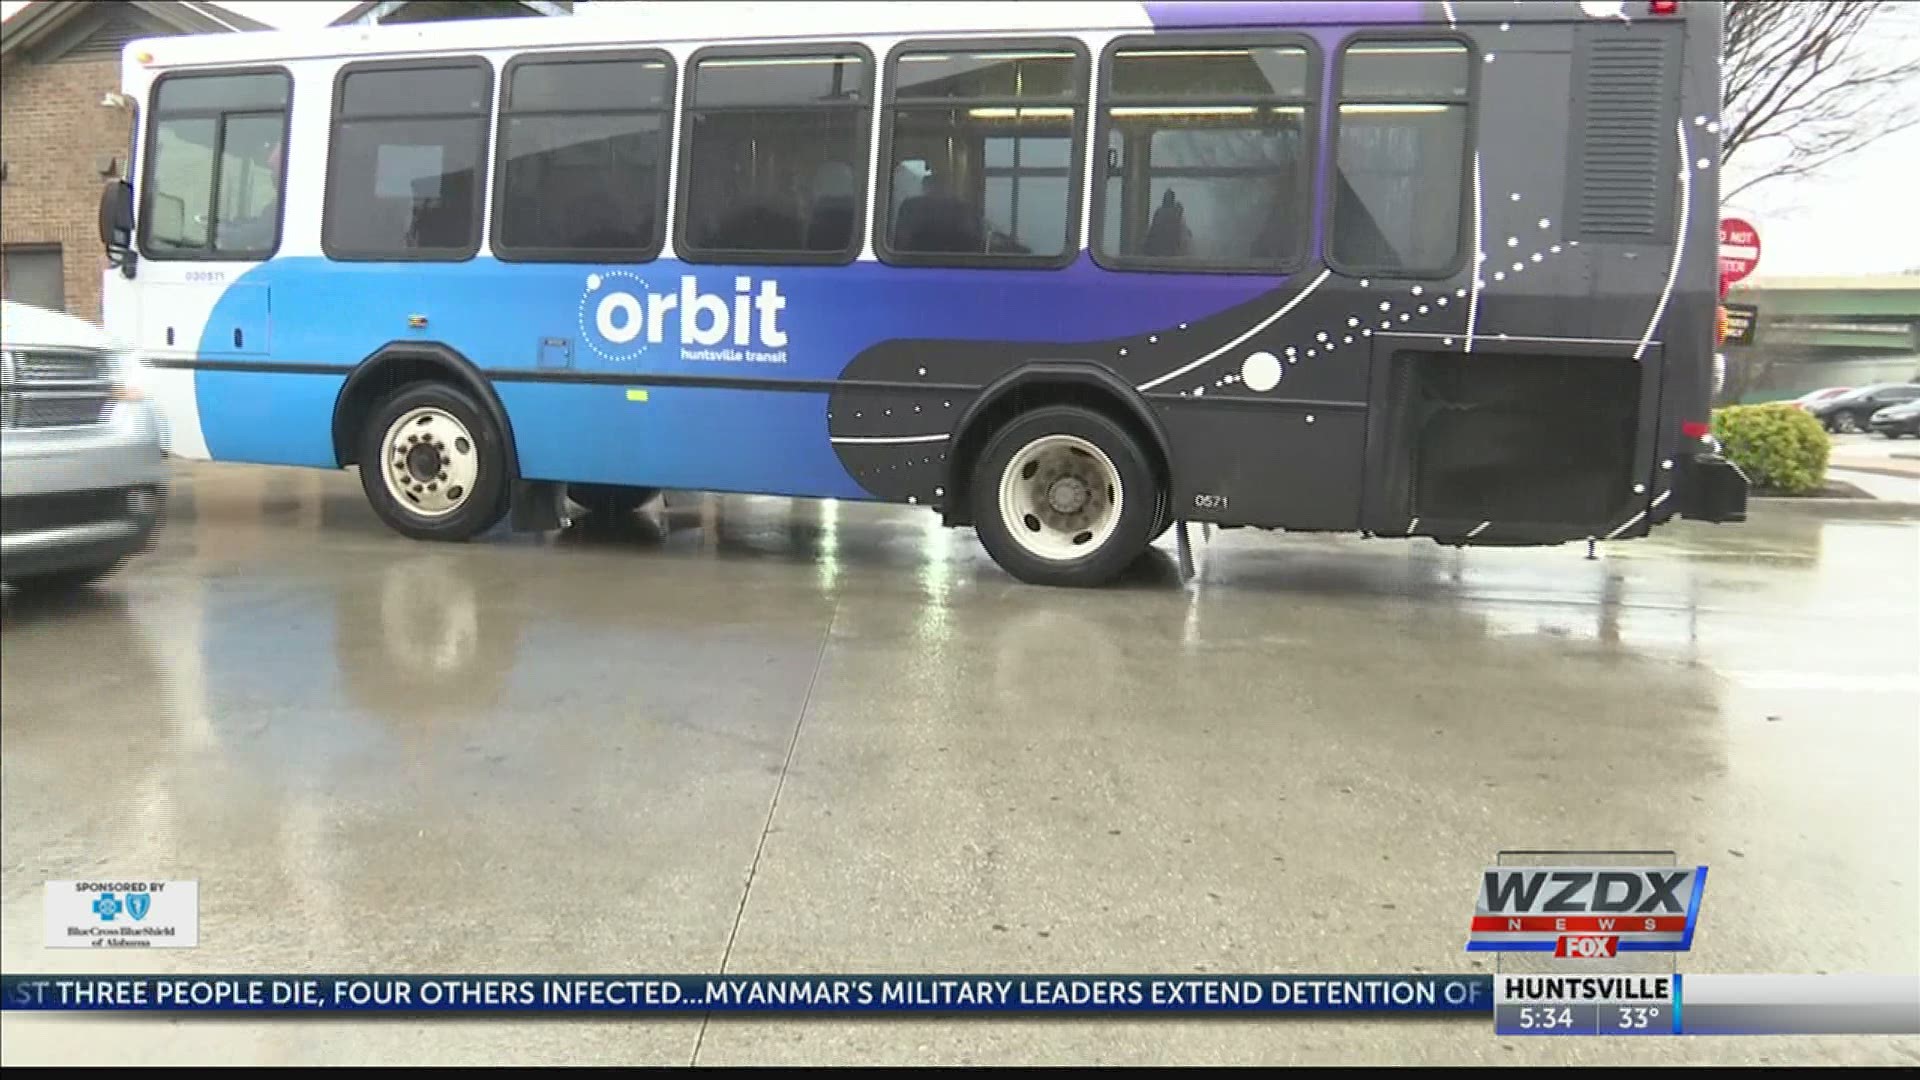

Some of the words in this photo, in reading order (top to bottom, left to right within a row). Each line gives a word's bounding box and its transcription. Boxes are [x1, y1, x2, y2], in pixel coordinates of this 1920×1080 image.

[1731, 231, 1754, 244] NOT
[596, 275, 788, 348] orbit
[680, 348, 743, 361] huntsville
[746, 350, 787, 363] transit
[1194, 494, 1229, 509] 0571
